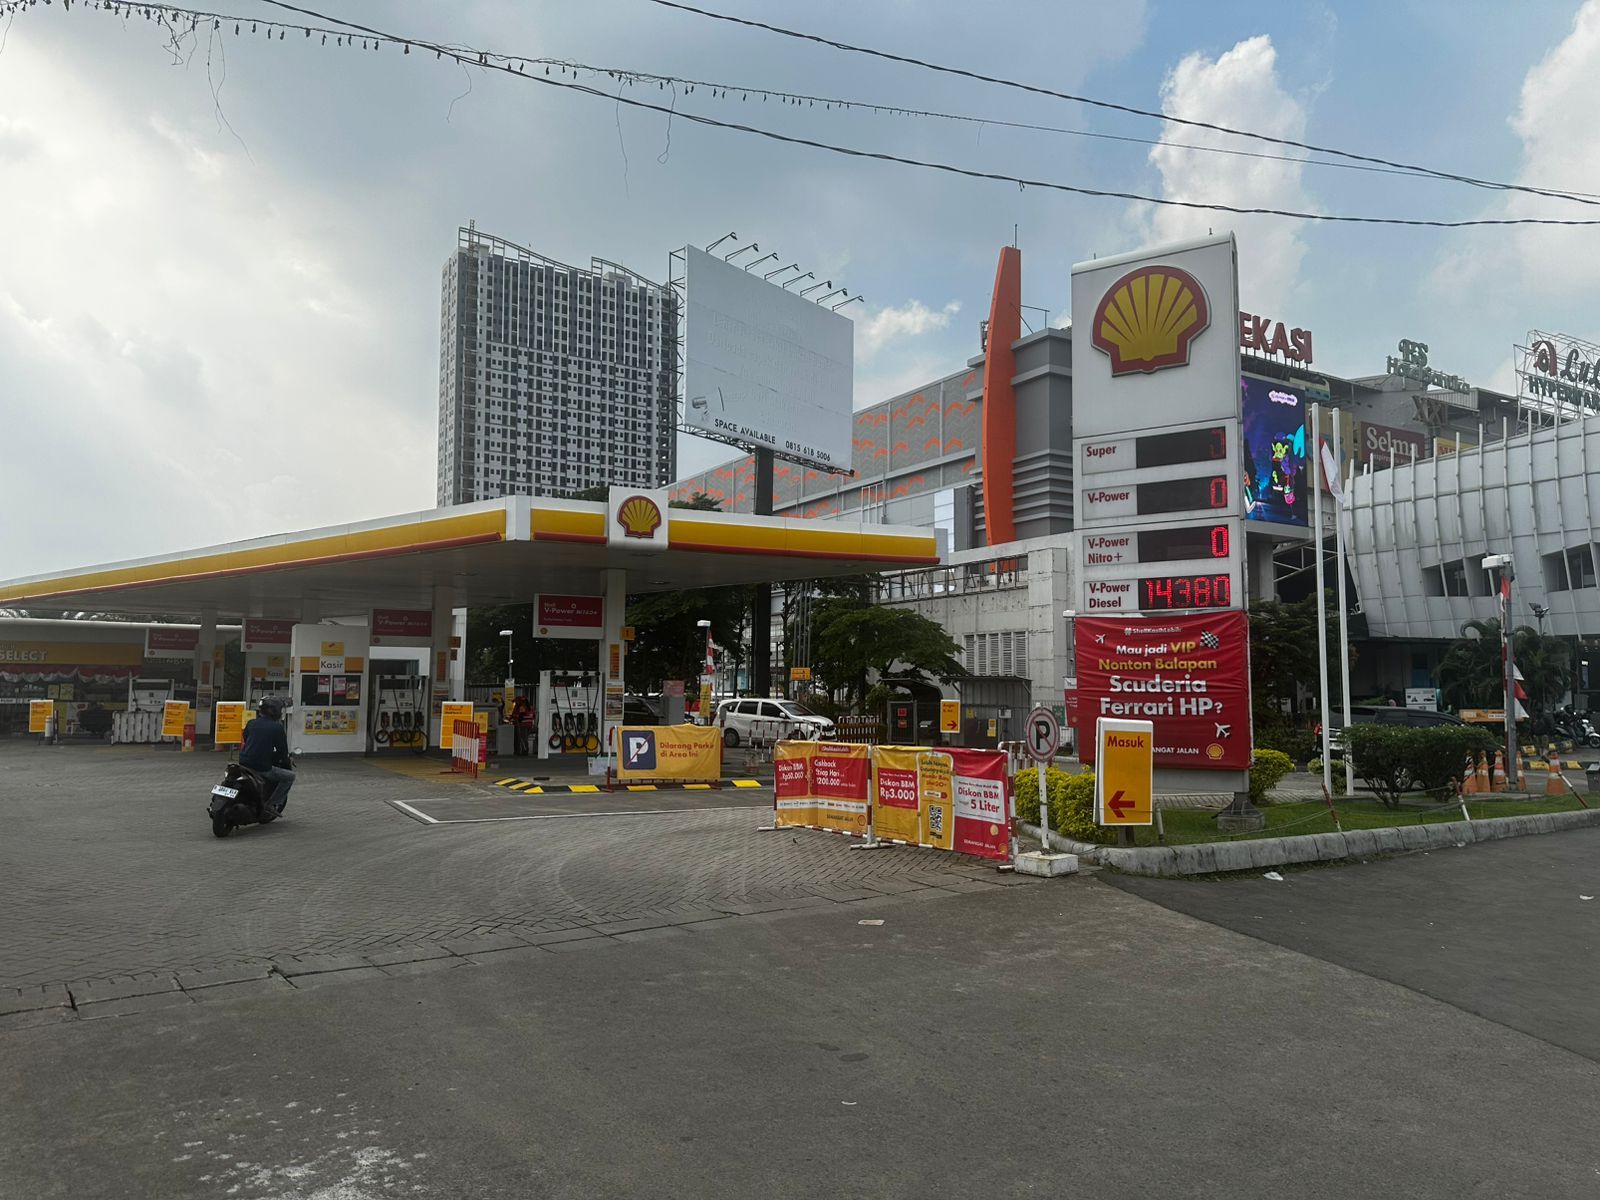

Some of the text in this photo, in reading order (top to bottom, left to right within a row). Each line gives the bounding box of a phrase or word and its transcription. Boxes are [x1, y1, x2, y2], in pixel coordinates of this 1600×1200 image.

[714, 418, 738, 433] SPACE
[740, 427, 776, 445] AVAILABLE
[785, 440, 801, 452] 0815
[817, 451, 831, 462] 5006
[1086, 445, 1117, 458] Super
[1087, 491, 1130, 504] V-Power
[1210, 477, 1227, 509] 0
[1088, 537, 1130, 550] V-Power
[1210, 526, 1229, 558] 0
[1089, 583, 1131, 594] V-Power
[1145, 575, 1231, 610] 14380
[1089, 596, 1121, 609] Diesel
[0, 650, 48, 661] SELECT
[1116, 641, 1197, 657] Mau jadi VIP
[320, 660, 343, 669] Kasir
[1098, 657, 1217, 672] Nonton Balapan
[1109, 673, 1207, 693] Scuderia
[1100, 696, 1174, 716] Ferrari
[1180, 697, 1223, 716] HP?
[1035, 720, 1050, 750] P
[1107, 735, 1144, 749] Masuk
[629, 737, 649, 762] P
[660, 742, 692, 750] Dilarang
[1176, 747, 1199, 755] JALAN
[880, 787, 915, 801] Rp3.000
[958, 786, 999, 799] Diskon BBM
[970, 799, 977, 809] 5
[979, 799, 1000, 813] Liter
